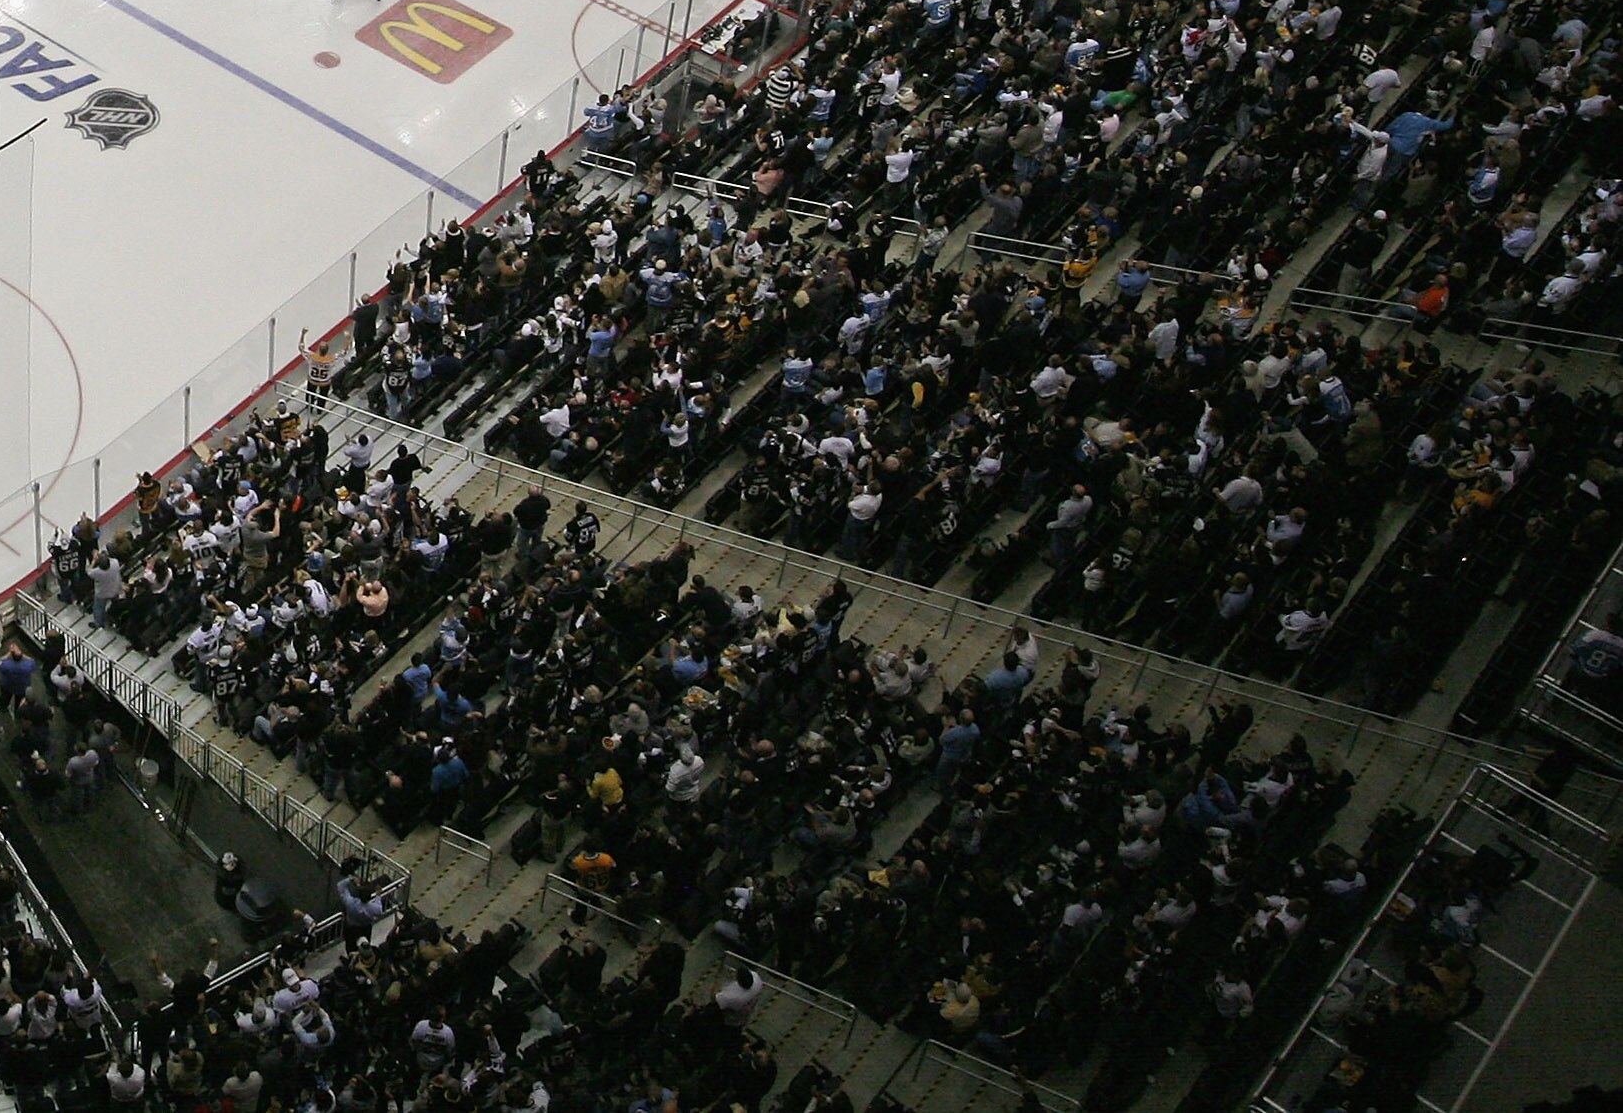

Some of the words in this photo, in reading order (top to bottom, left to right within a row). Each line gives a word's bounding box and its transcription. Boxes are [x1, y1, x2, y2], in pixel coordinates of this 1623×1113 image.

[310, 366, 329, 380] 25
[58, 559, 80, 573] 66
[215, 678, 239, 697] 87
